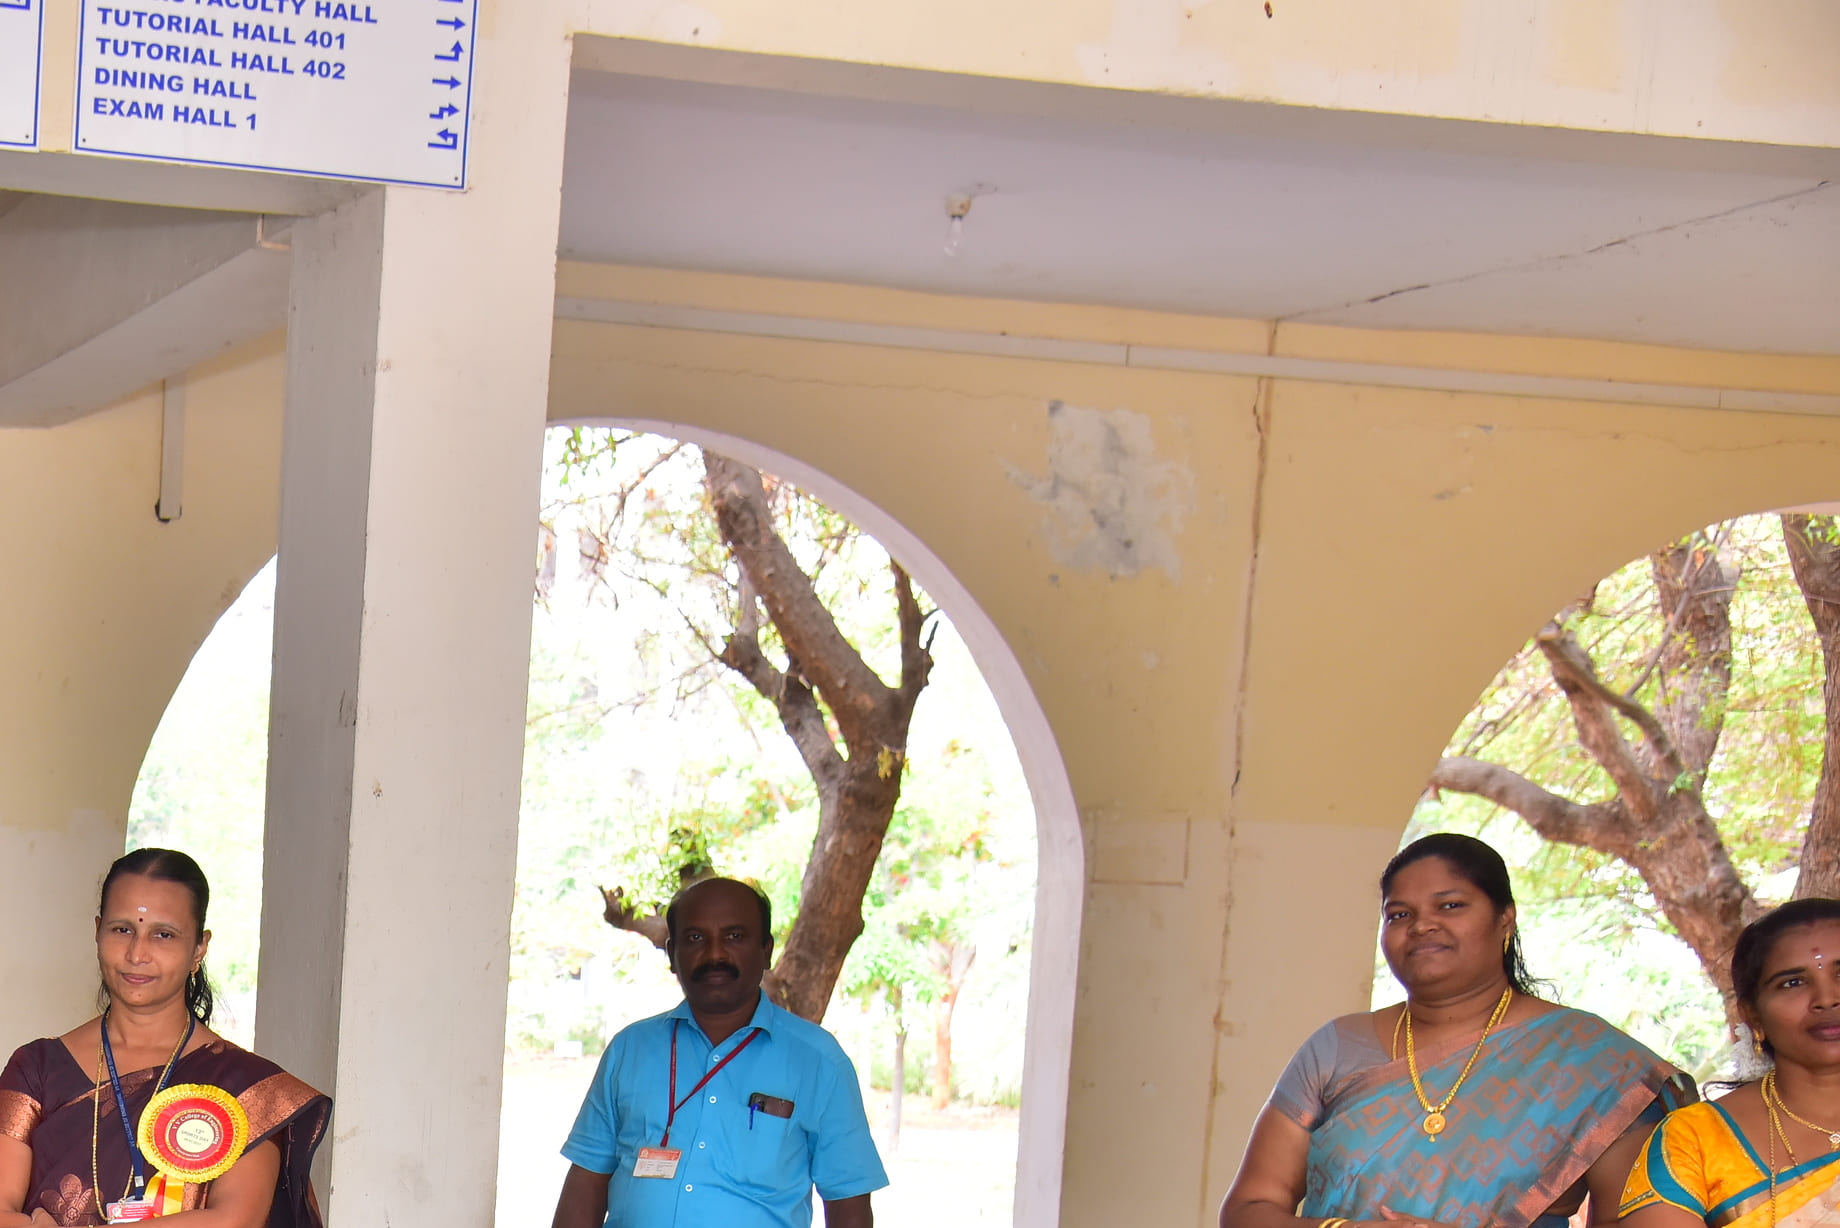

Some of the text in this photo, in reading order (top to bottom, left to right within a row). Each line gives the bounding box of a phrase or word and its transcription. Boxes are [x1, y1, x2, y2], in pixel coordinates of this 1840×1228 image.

[97, 7, 346, 50] TUTORIAL HALL 401
[314, 0, 377, 24] HALL
[95, 37, 346, 81] TUTORIAL HALL 402
[94, 67, 257, 101] DINING HALL
[93, 97, 257, 131] EXAM HALL 1
